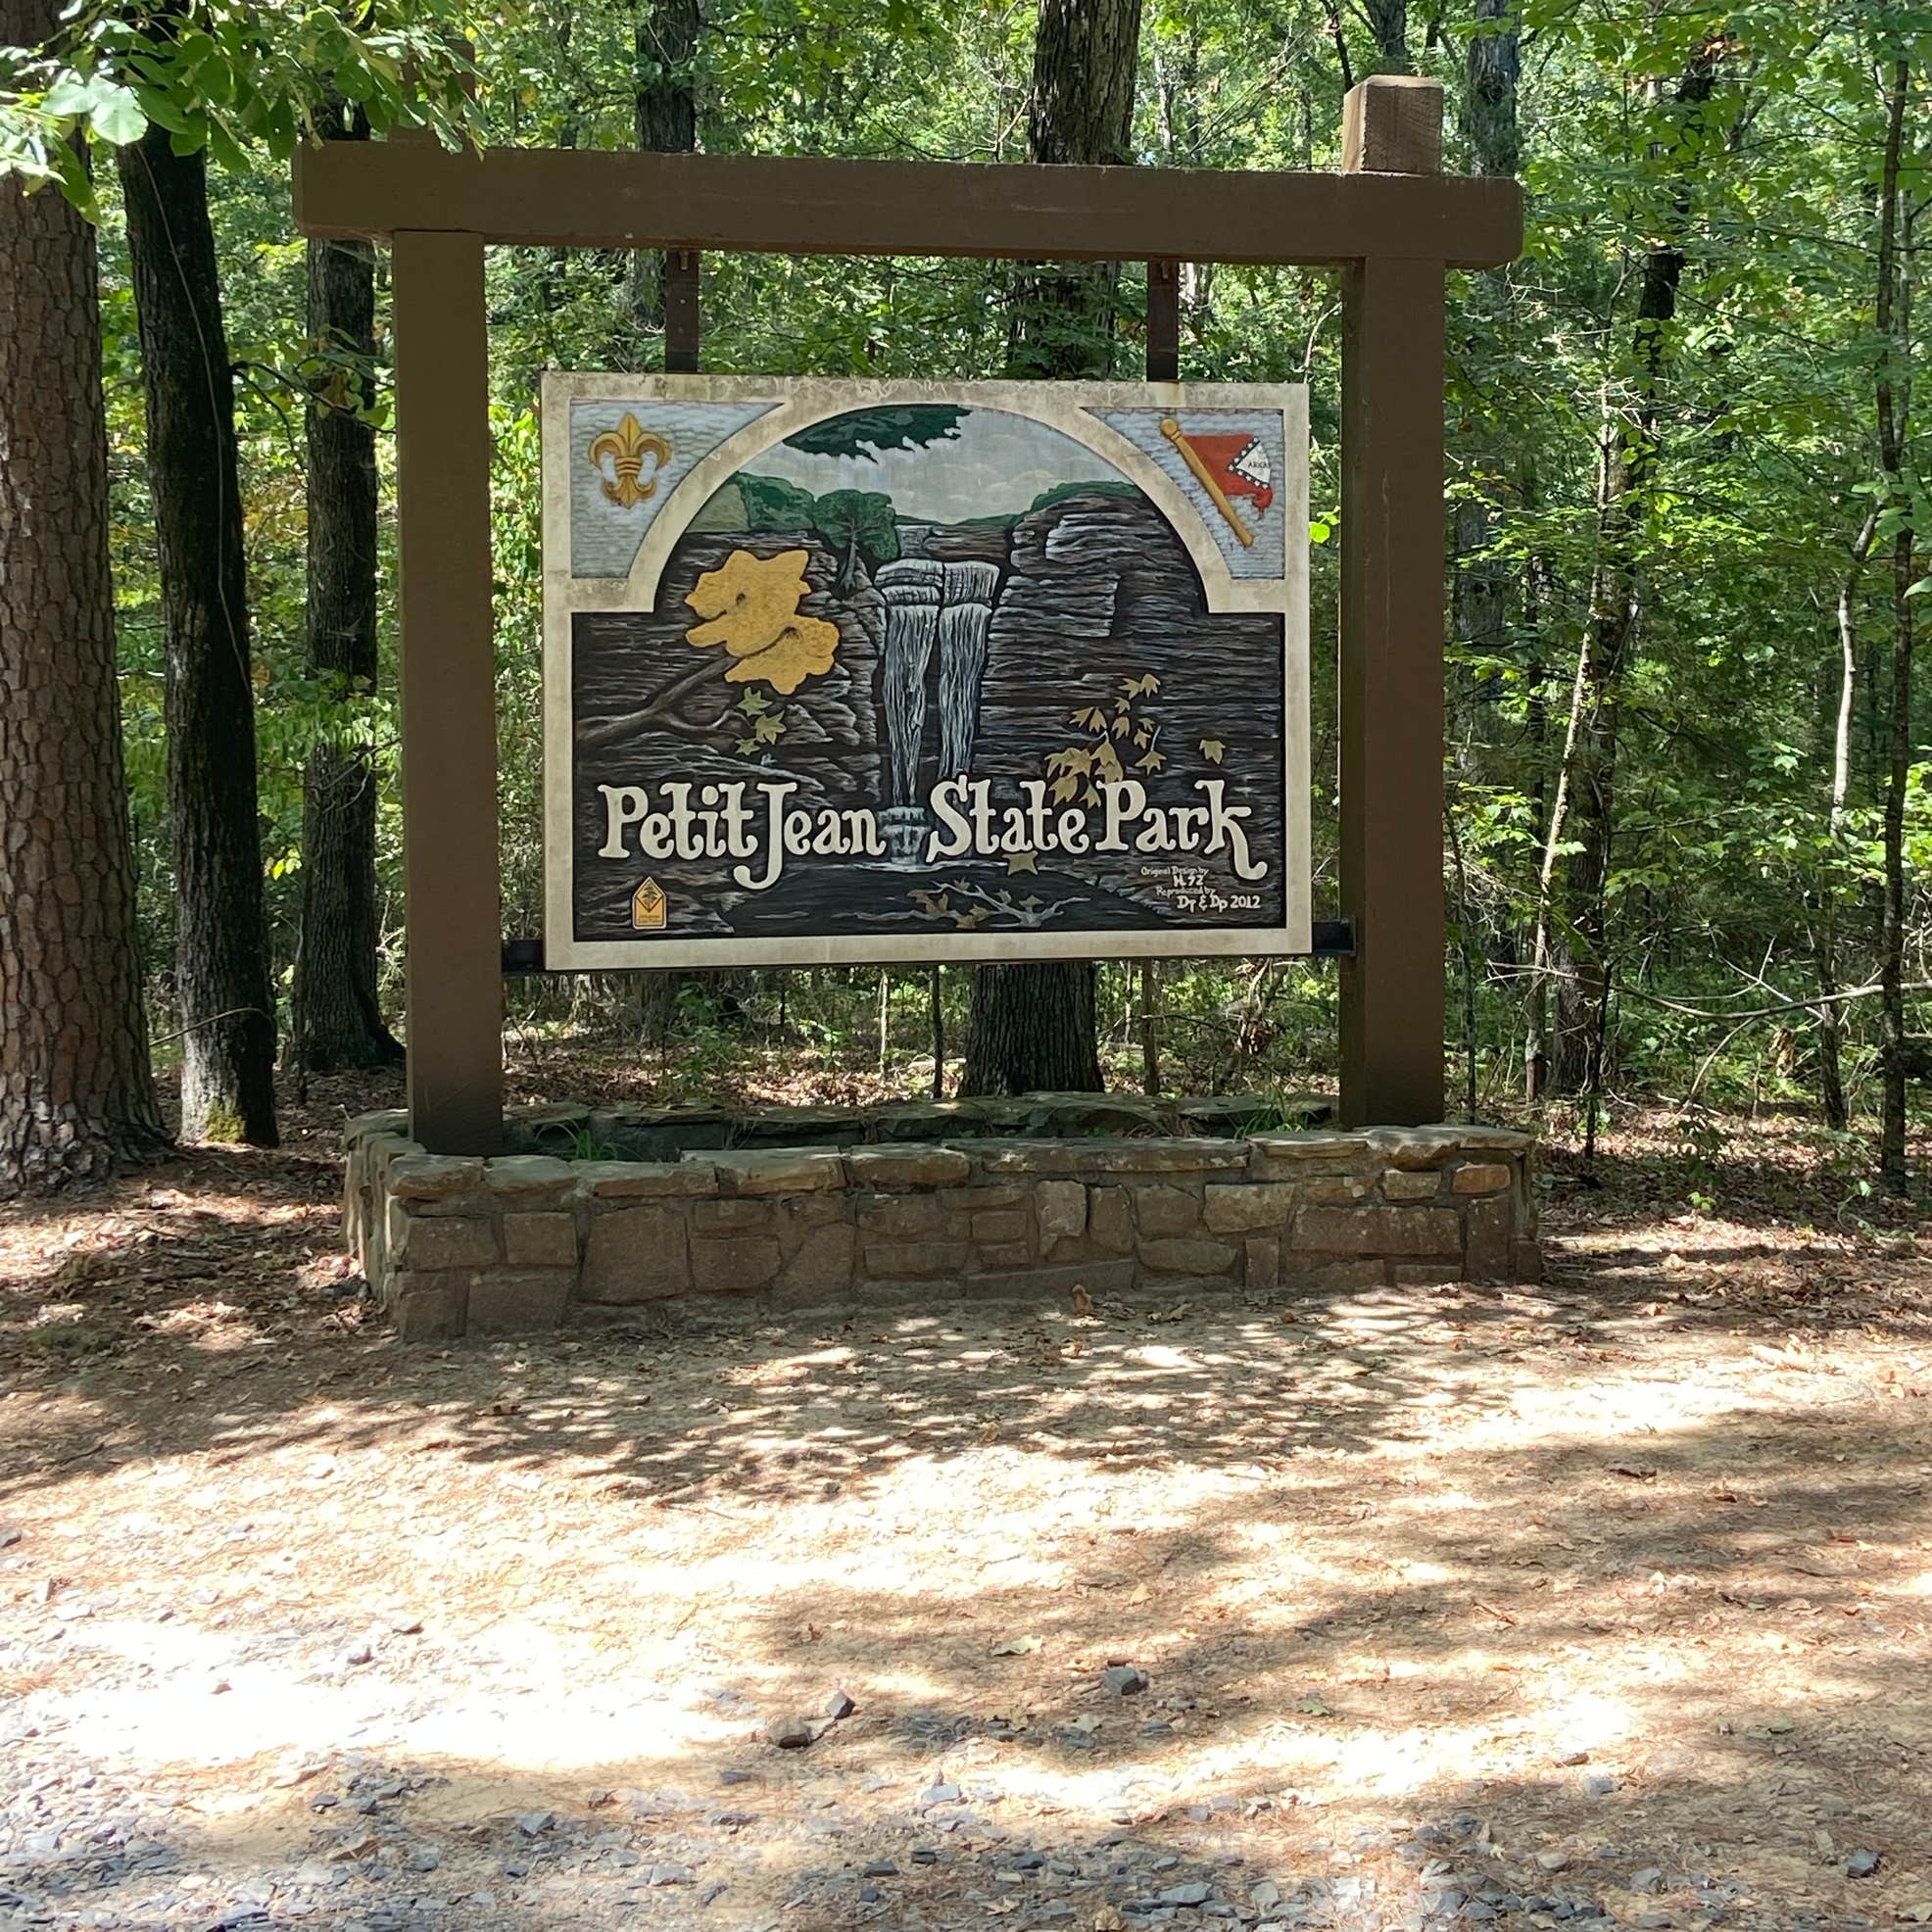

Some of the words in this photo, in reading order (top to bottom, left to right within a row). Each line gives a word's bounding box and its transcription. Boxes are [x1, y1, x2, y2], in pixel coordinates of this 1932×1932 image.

[598, 782, 758, 860] Petit
[733, 782, 886, 890] Jean
[926, 774, 1089, 864] State
[1094, 780, 1269, 881] Park
[1230, 894, 1262, 909] 2012
